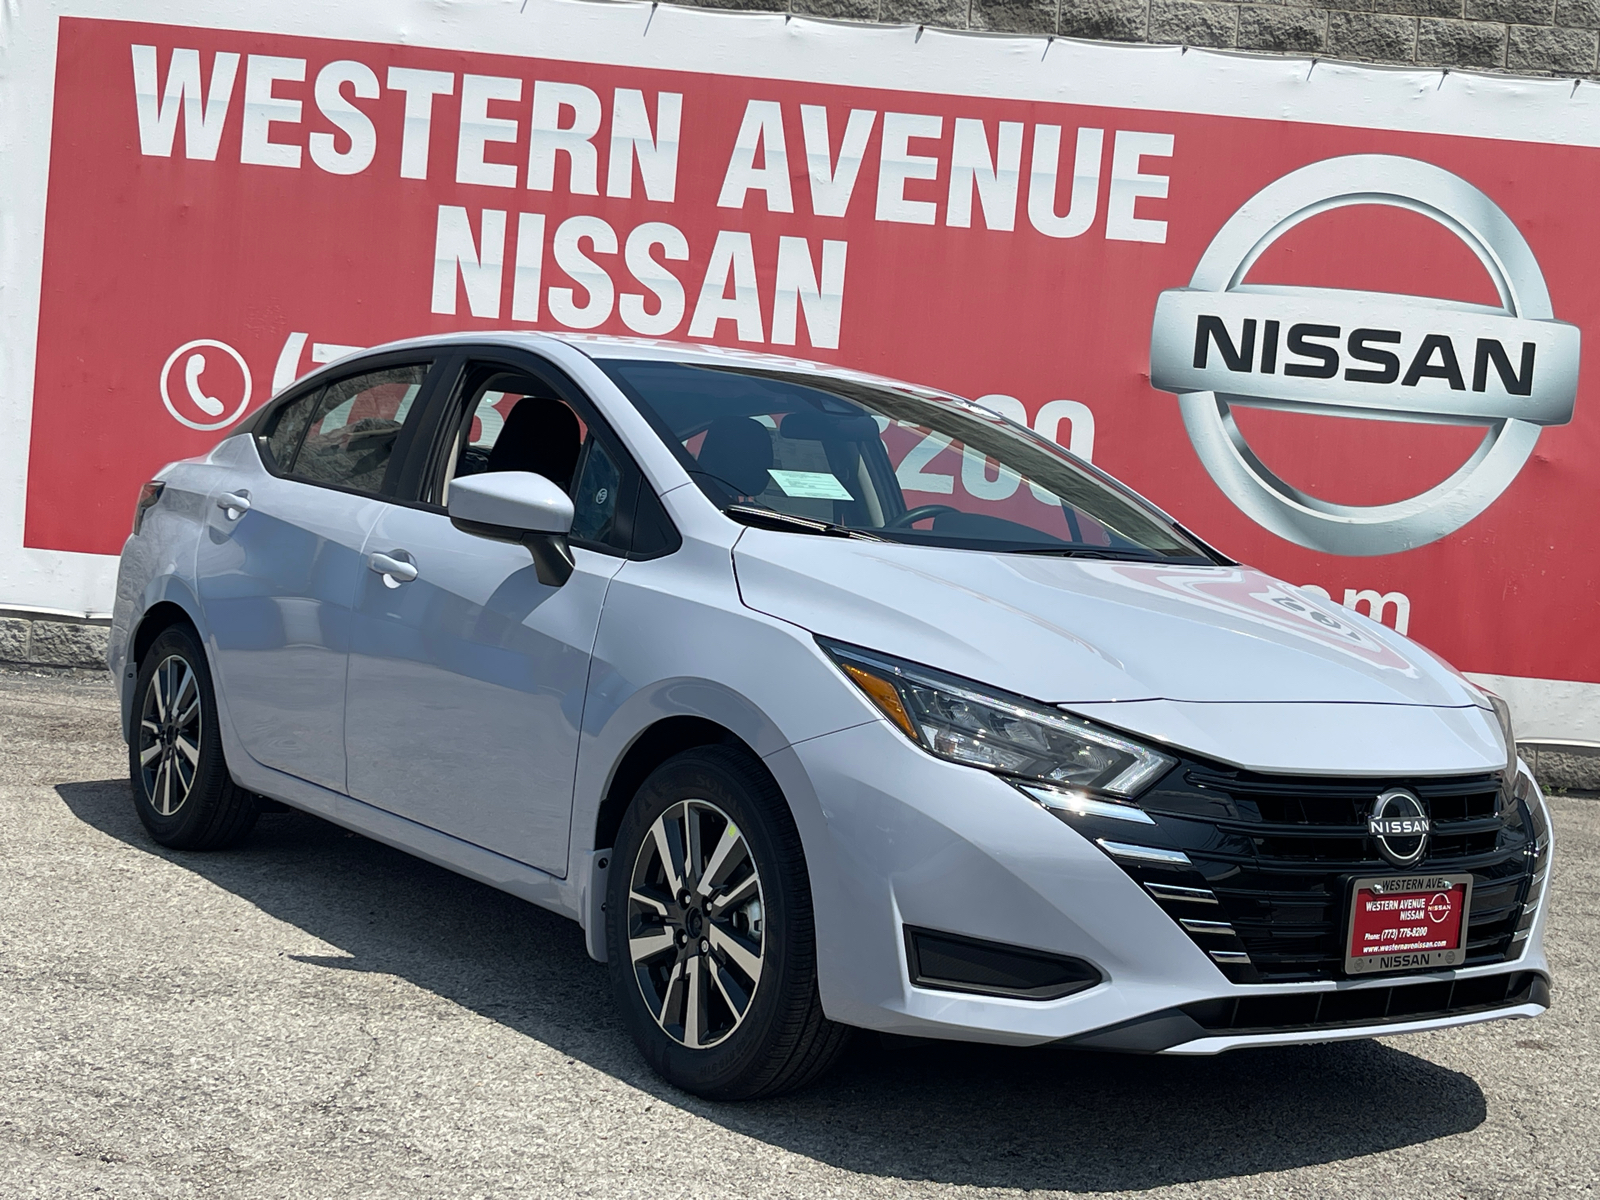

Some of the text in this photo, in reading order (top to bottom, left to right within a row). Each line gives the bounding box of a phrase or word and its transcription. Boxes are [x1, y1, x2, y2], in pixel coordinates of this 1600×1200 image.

[131, 44, 1175, 244] WESTERN AVENUE
[431, 205, 848, 350] NISSAN
[1193, 315, 1536, 396] NISSAN
[1371, 820, 1429, 833] NISSAN
[1382, 879, 1424, 891] WESTERN
[1366, 898, 1425, 911] WESTERN AVENUE
[1400, 909, 1424, 921] NISSAN
[1381, 929, 1398, 941] (773)
[1380, 953, 1430, 968] NISSAN
